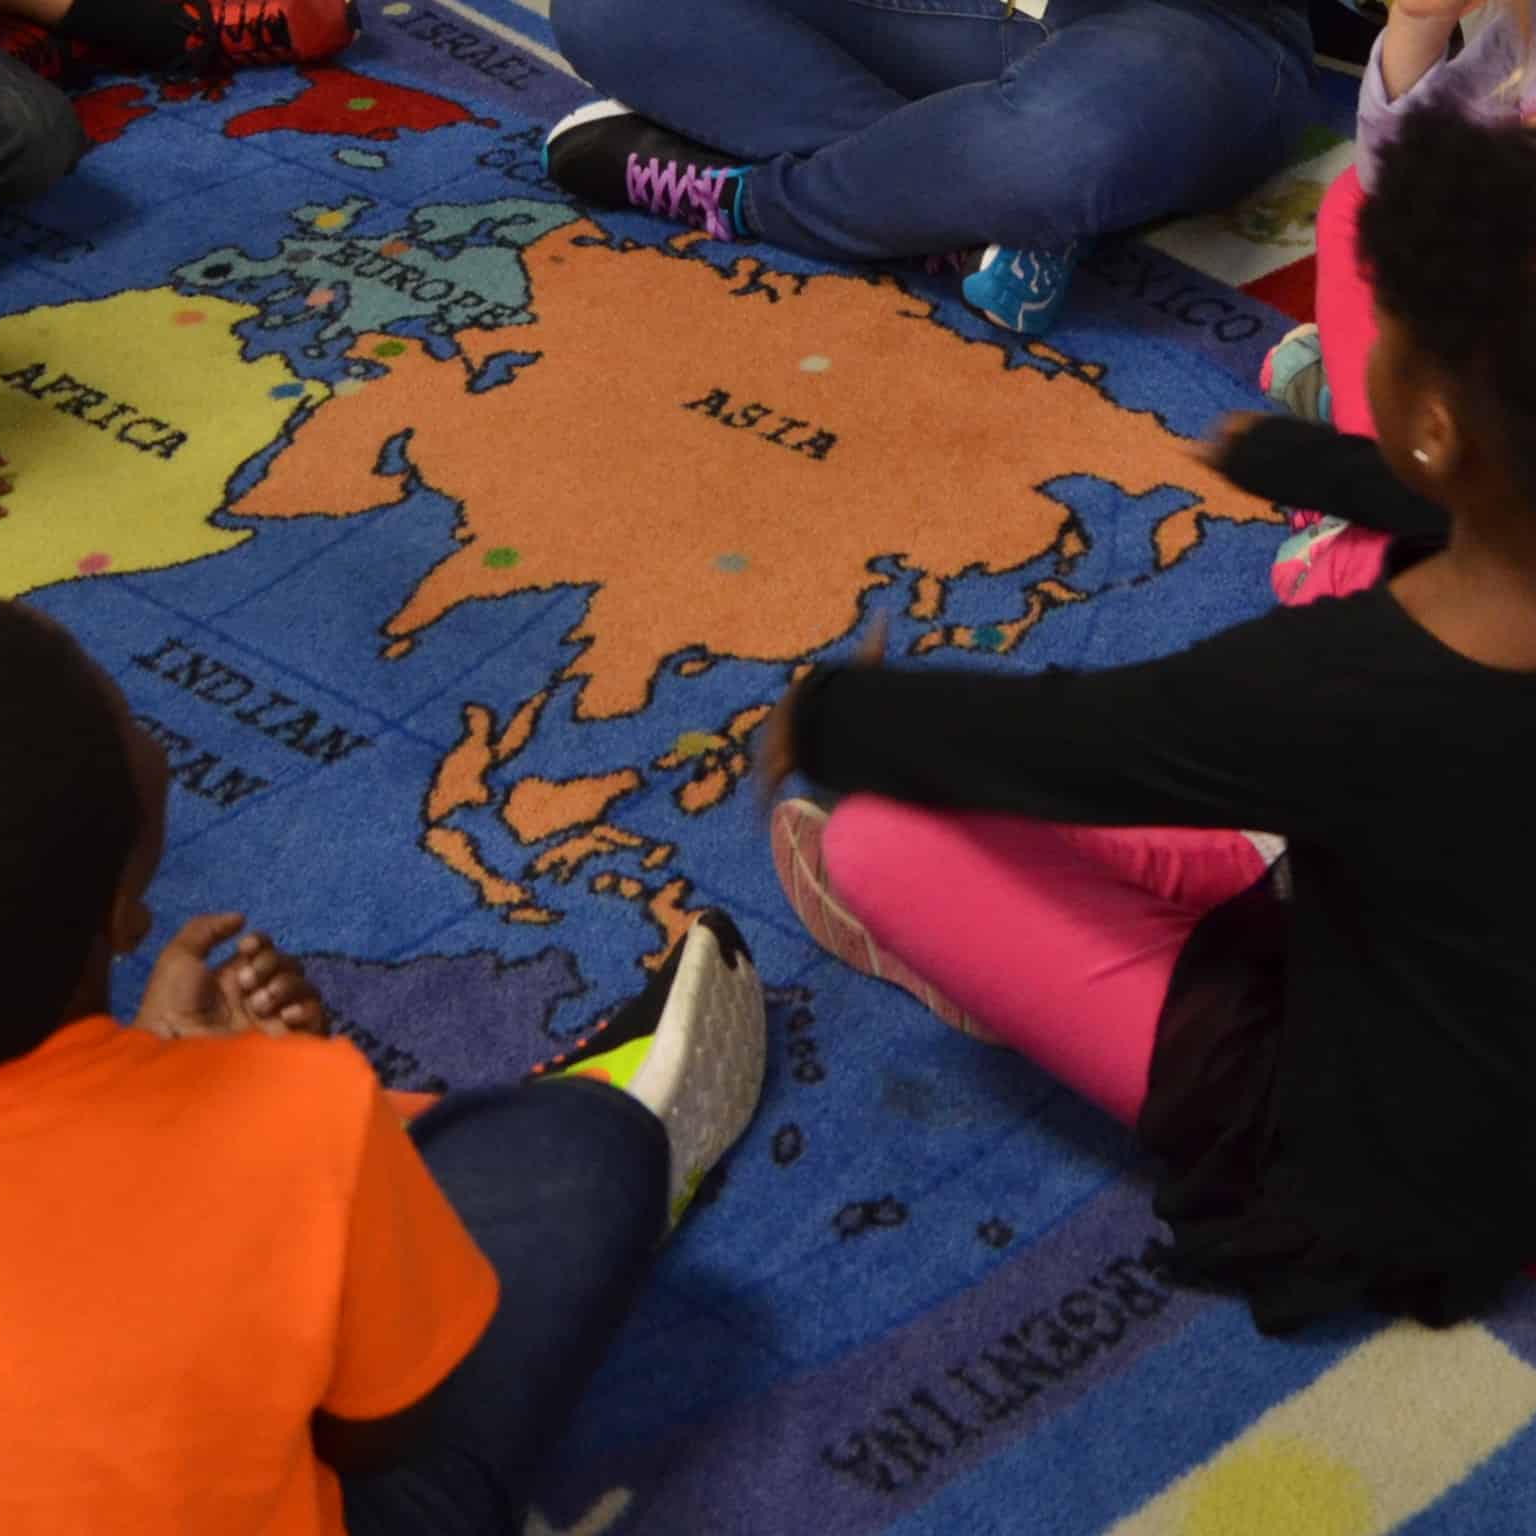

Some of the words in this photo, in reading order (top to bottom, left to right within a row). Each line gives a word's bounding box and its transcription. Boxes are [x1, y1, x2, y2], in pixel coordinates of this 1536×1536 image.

[391, 7, 546, 91] ISRAEL
[323, 239, 526, 328] EUROPE
[0, 361, 189, 461] AFRICA
[682, 387, 841, 461] ASIA
[131, 636, 373, 764] INDIAN
